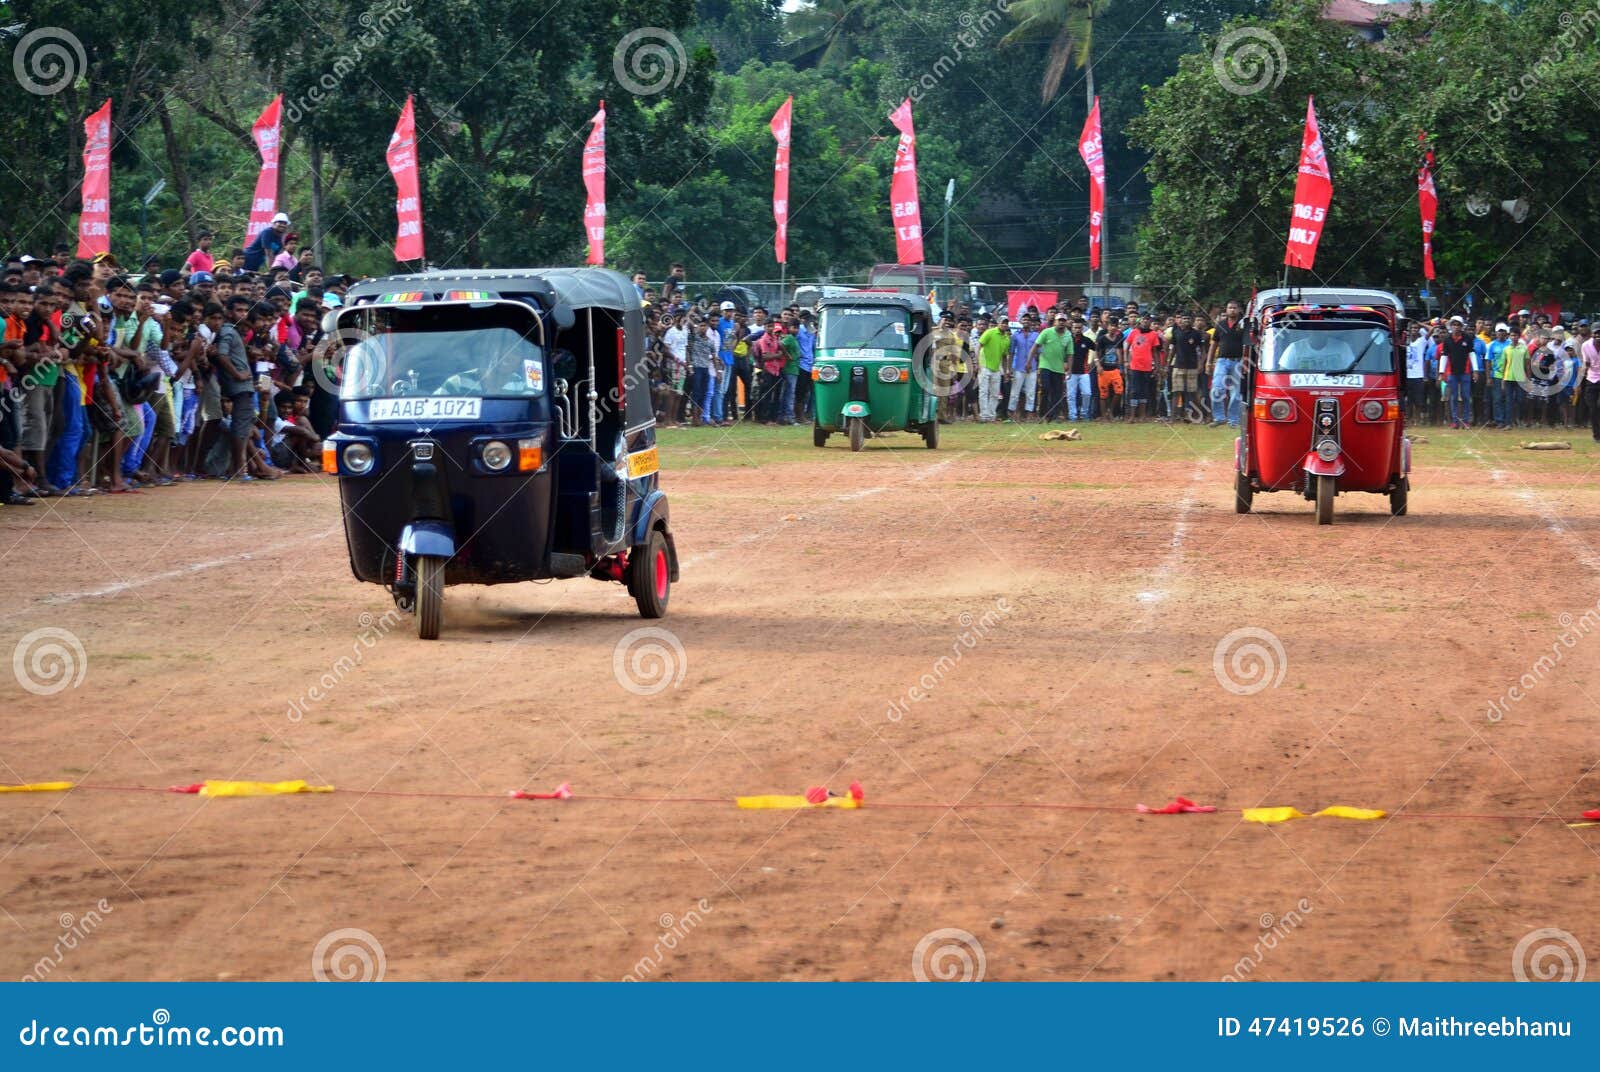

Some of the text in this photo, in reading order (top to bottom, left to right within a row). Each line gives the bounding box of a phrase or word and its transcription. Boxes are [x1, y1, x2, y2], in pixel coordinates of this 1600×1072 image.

[1303, 374, 1319, 385] YX
[1332, 374, 1362, 385] 5721
[390, 400, 425, 416] AAB
[432, 400, 477, 416] 1071
